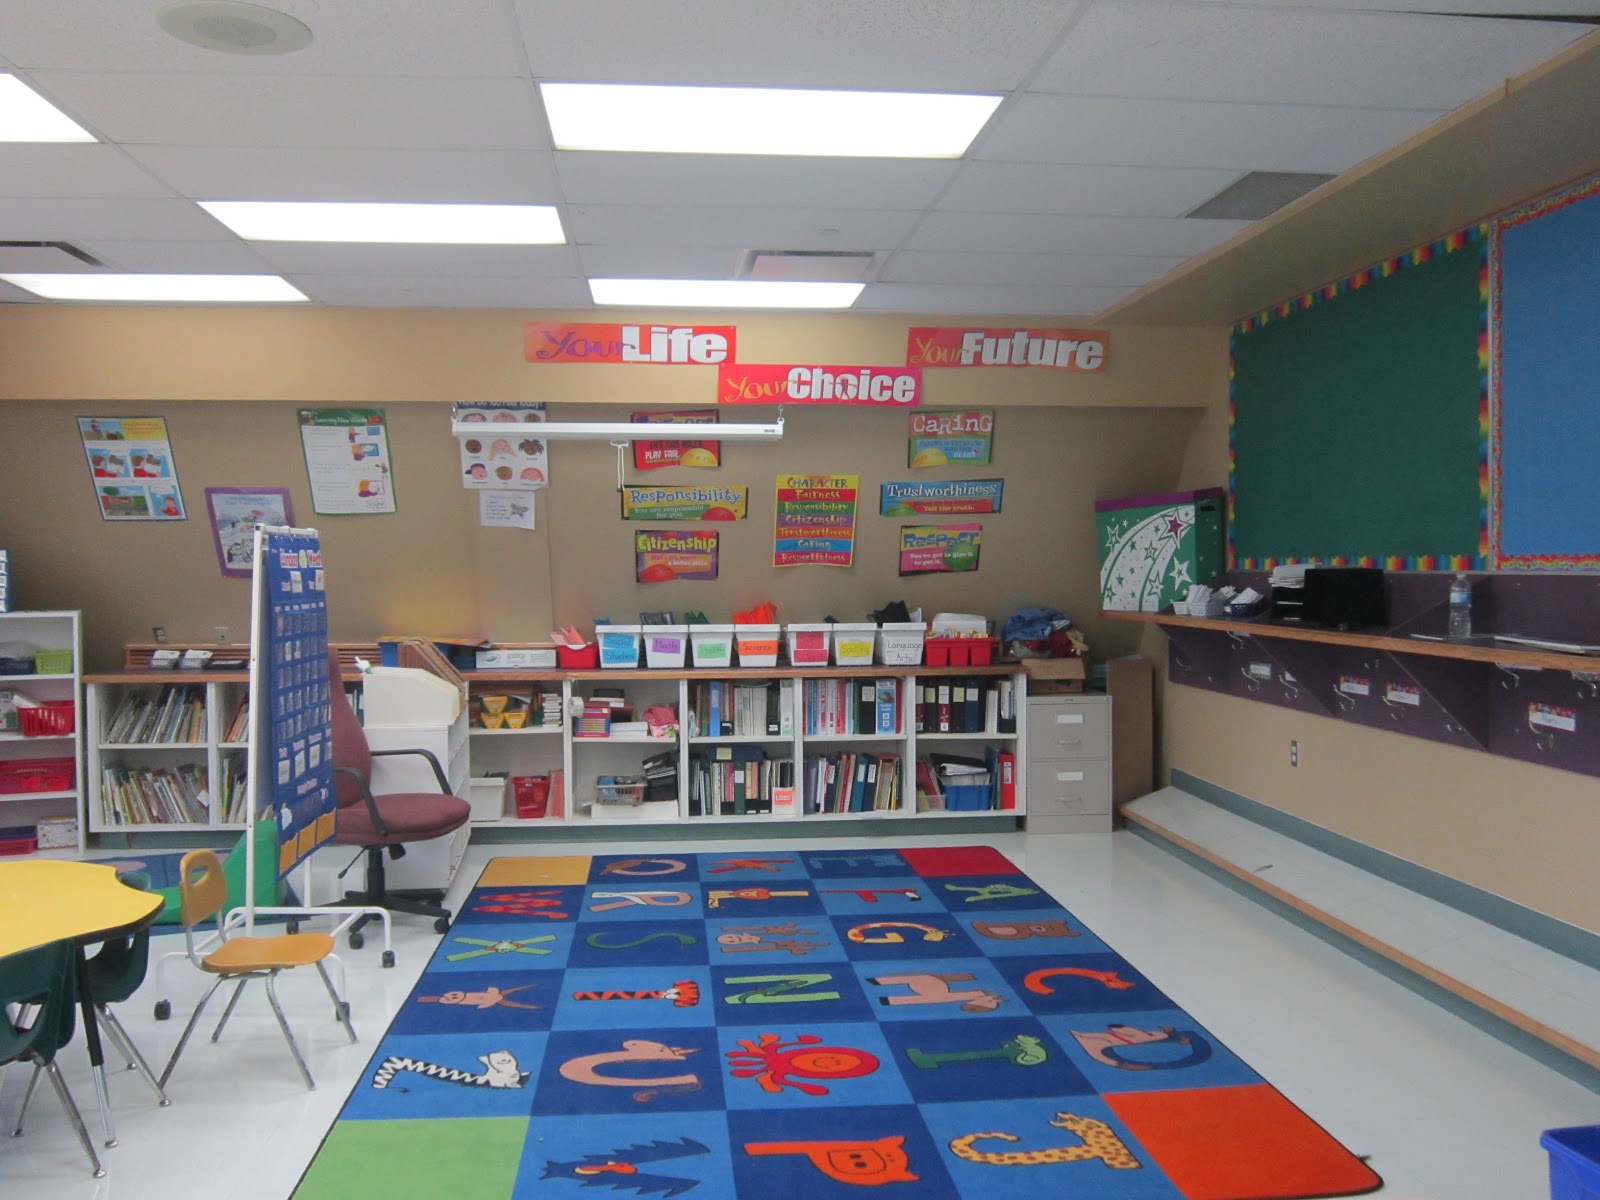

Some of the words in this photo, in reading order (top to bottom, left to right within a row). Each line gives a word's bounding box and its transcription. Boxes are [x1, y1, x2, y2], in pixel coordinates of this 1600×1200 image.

[535, 331, 636, 359] Your
[621, 326, 728, 363] Life
[909, 336, 969, 364] Your
[961, 331, 1104, 369] Future
[724, 376, 796, 402] Your
[787, 367, 916, 402] Choice
[644, 450, 661, 460] PLAY
[787, 477, 848, 488] CHARACTER
[795, 489, 841, 500] Fairness
[887, 483, 997, 497] Trustworthiness
[630, 488, 742, 504] Responsibility
[784, 502, 849, 513] Responsibility
[785, 515, 847, 526] Citizenship
[778, 528, 850, 537] Trustworthiness
[636, 534, 717, 553] Citizenship
[797, 540, 831, 550] Caring
[781, 553, 846, 562] Respectfulness
[606, 635, 631, 646] Social
[655, 640, 678, 650] Math
[887, 641, 923, 651] Language
[743, 643, 772, 651] Science
[605, 652, 635, 660] Studies
[896, 653, 912, 662] Arts
